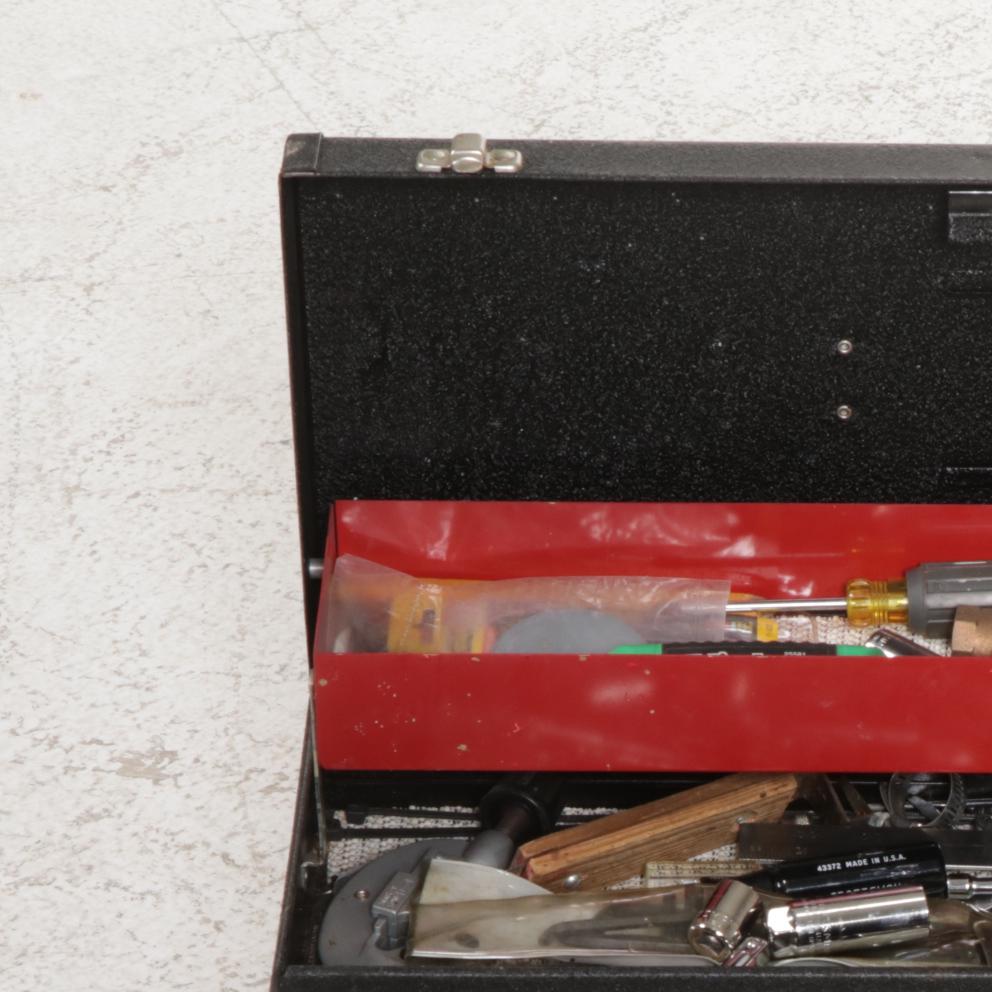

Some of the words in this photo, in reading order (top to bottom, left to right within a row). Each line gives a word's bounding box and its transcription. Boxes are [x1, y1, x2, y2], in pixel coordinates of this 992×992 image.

[816, 863, 842, 873] 43372
[845, 858, 869, 869] MADE
[871, 857, 881, 865] IN
[883, 853, 907, 864] U.S.A.
